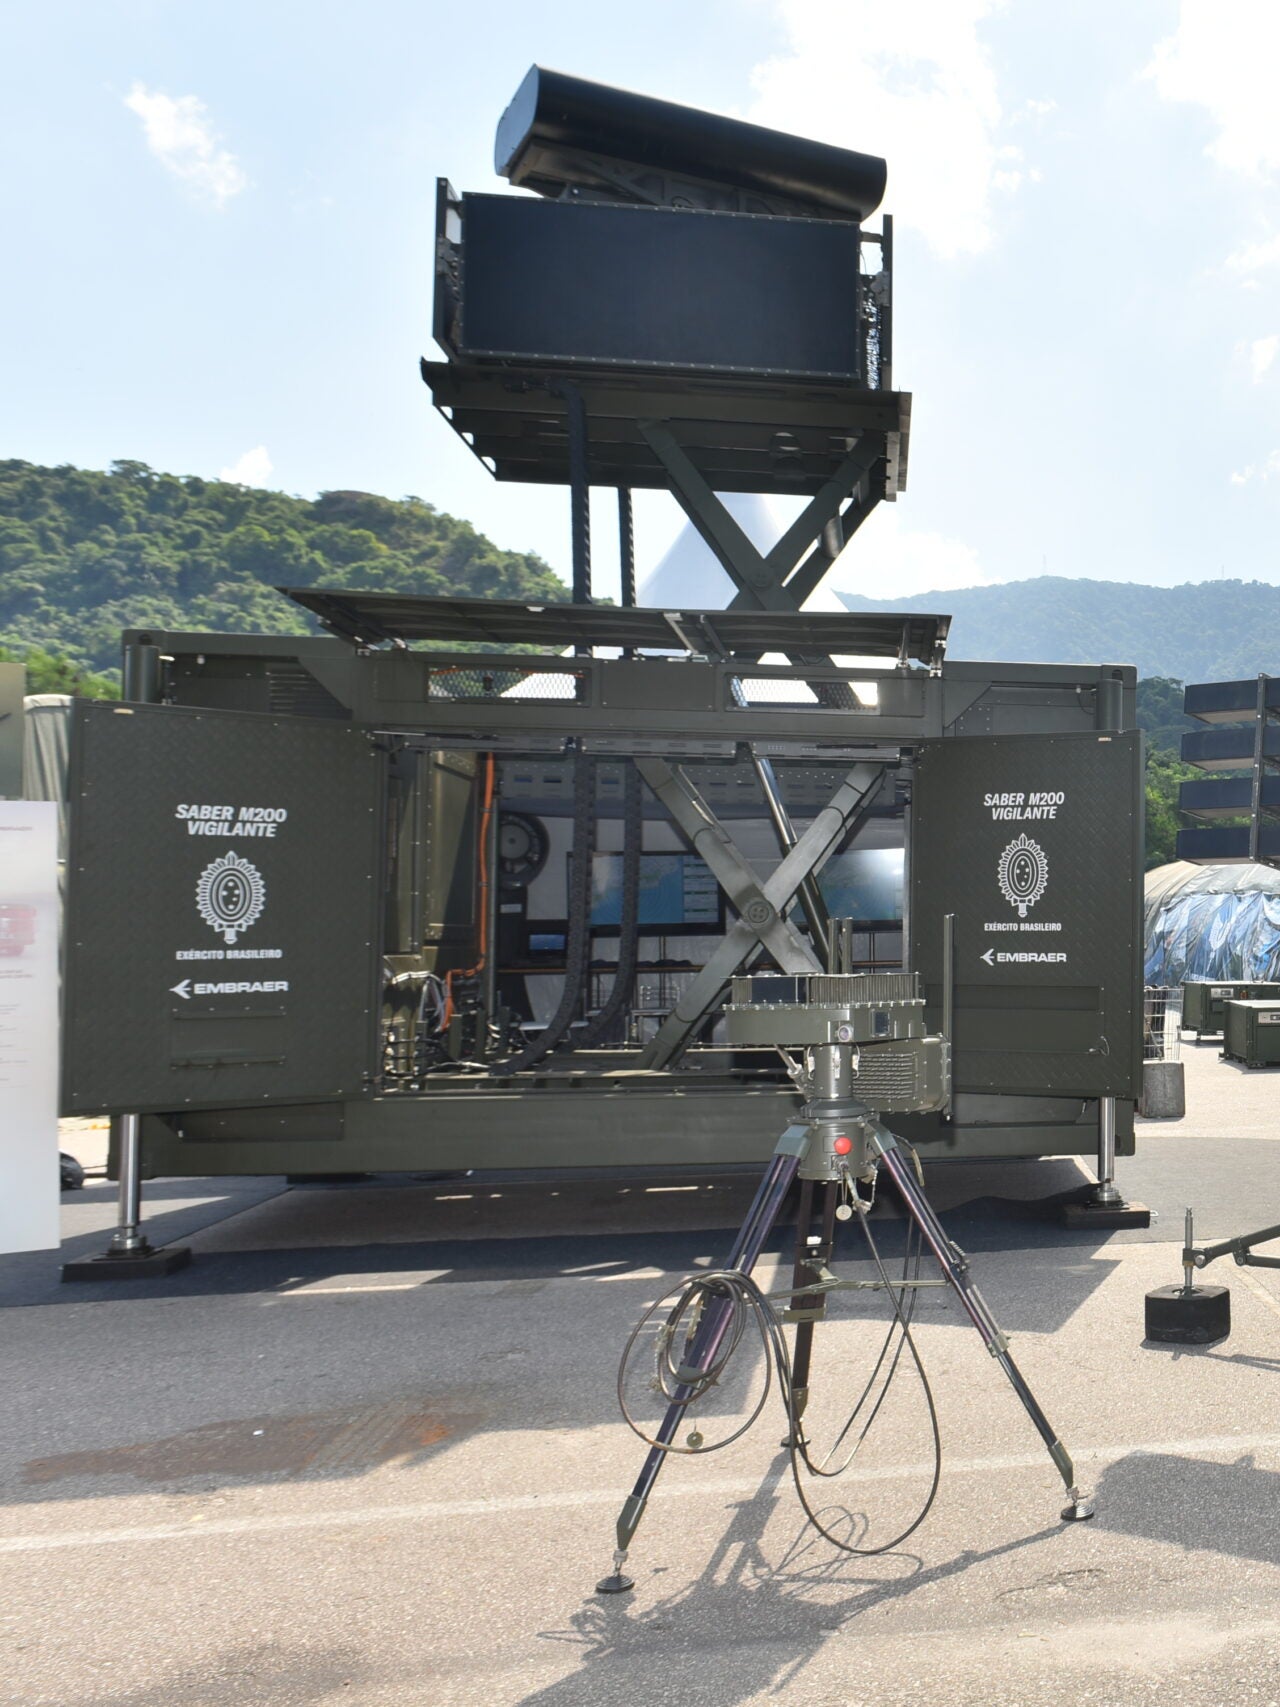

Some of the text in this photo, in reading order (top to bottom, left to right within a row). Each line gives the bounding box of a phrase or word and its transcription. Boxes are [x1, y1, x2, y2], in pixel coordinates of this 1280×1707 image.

[983, 792, 1065, 806] SABER M200
[175, 804, 288, 823] SABER M200
[991, 806, 1058, 820] VIGILANTE
[187, 821, 278, 837] VIGILANTE
[984, 921, 1062, 932] EXÉRCITO BRASILEIRO
[176, 948, 283, 960] EXÉRCITO BRASILEIRO
[996, 952, 1067, 963] EMBRAER
[194, 981, 289, 995] EMBRAER
